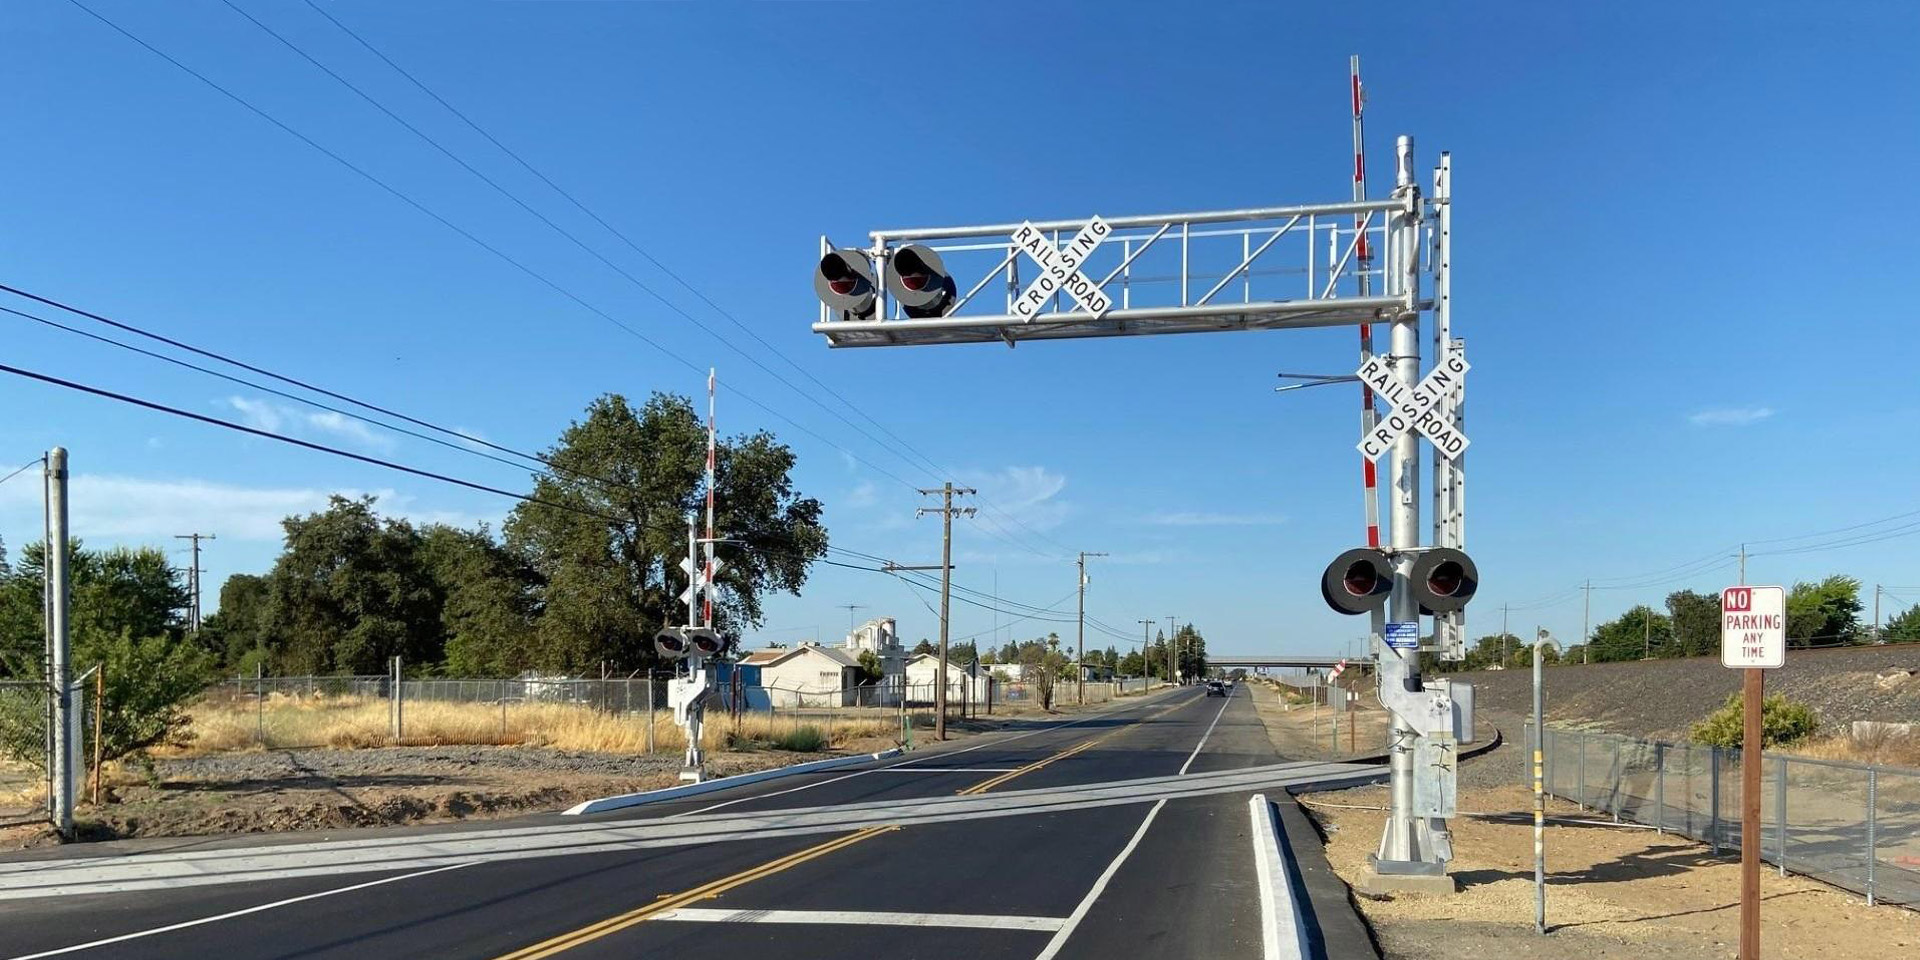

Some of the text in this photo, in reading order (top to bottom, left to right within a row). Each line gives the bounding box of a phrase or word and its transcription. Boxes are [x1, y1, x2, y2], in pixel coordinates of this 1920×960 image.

[1018, 222, 1106, 315] CROSSING
[1364, 358, 1464, 456] CROSSING
[1726, 590, 1748, 609] NO
[1726, 614, 1781, 630] PARKING
[1743, 632, 1764, 643] ANY
[1742, 646, 1765, 658] TIME
